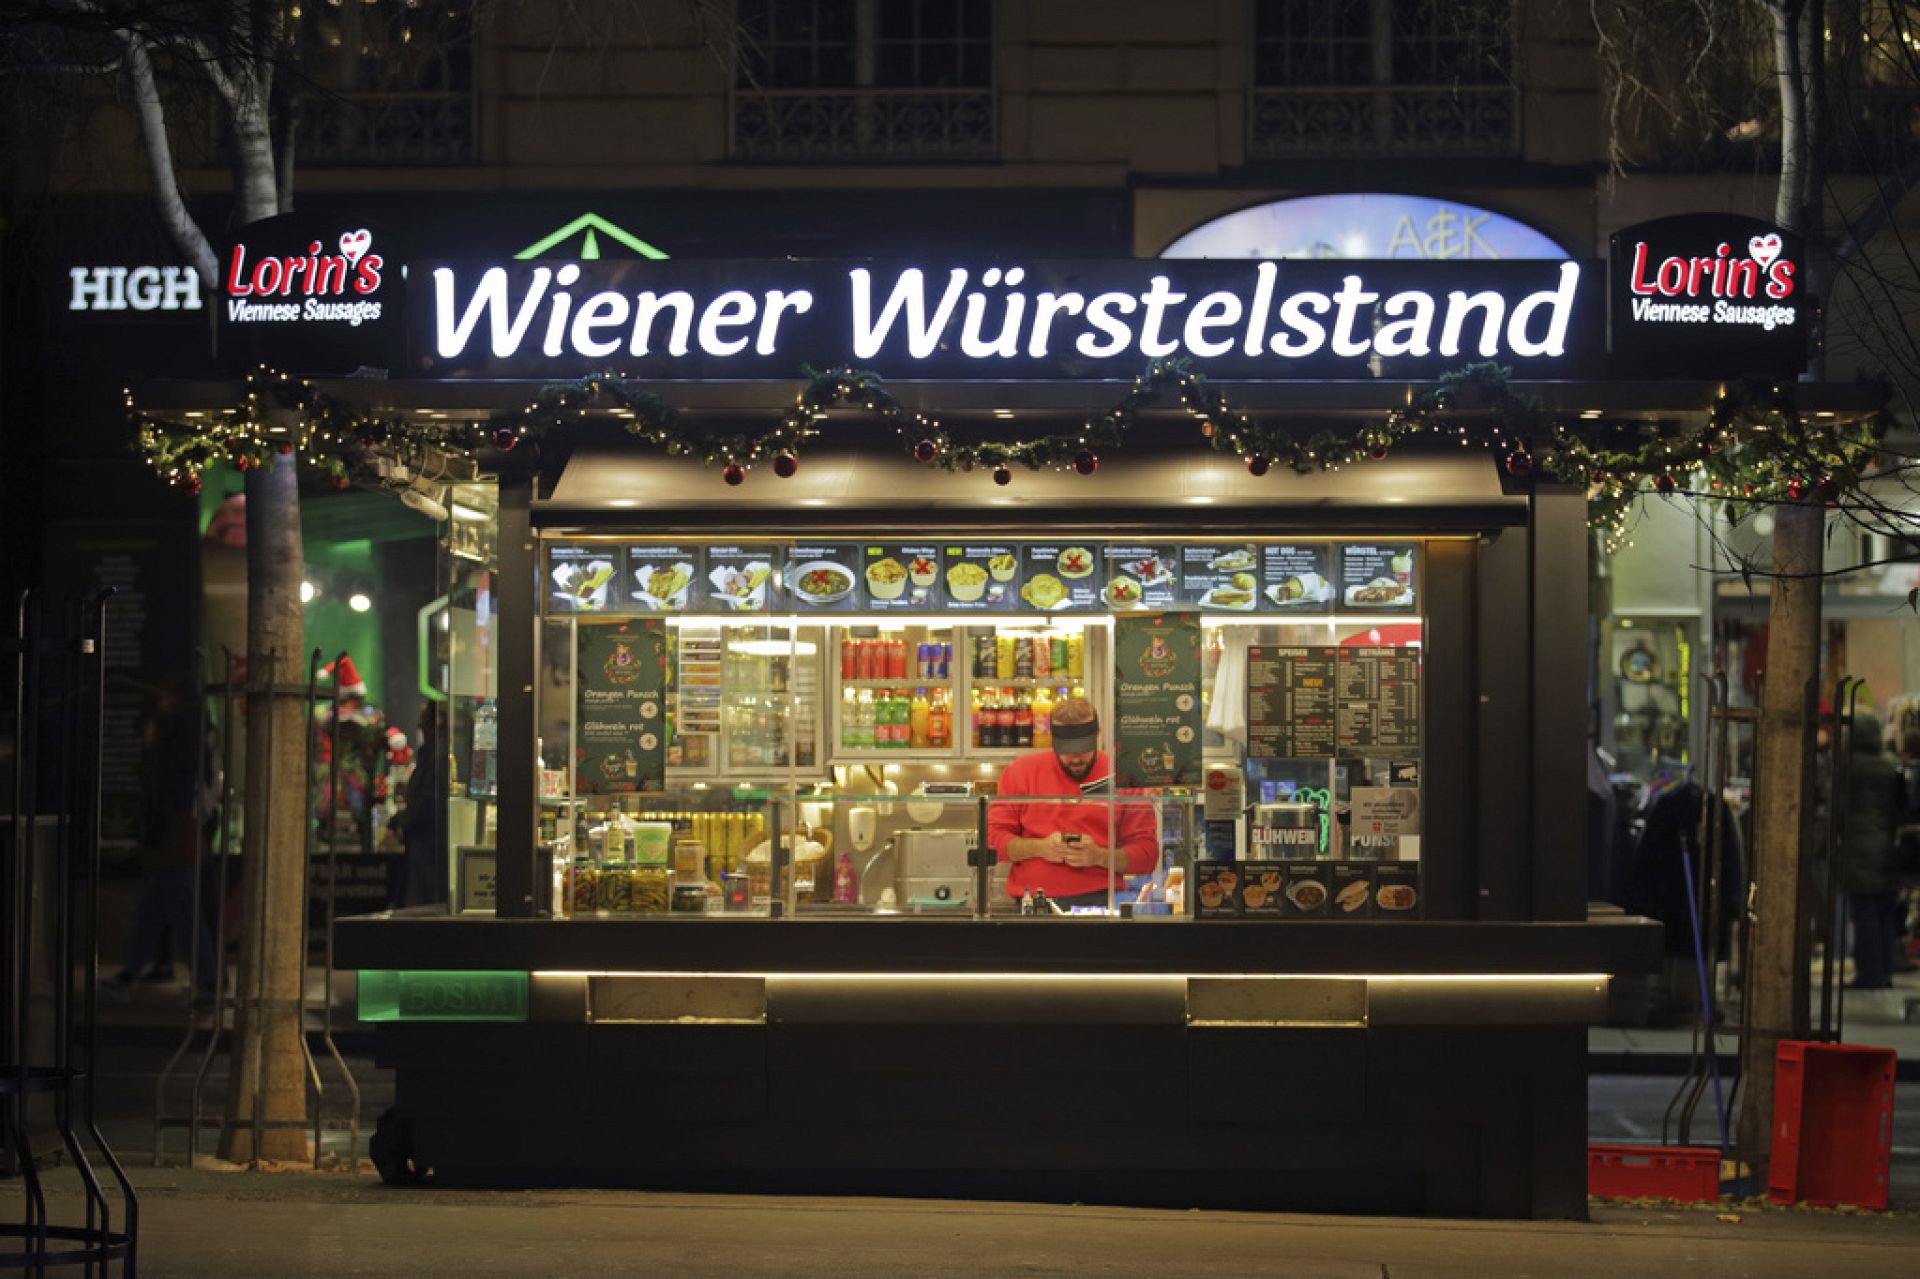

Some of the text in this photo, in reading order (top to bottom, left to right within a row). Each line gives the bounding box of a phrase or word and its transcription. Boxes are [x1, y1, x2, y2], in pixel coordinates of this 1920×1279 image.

[68, 265, 201, 311] HIGH
[227, 240, 384, 297] Lorin's
[1630, 241, 1796, 298] Lorin's
[227, 297, 382, 327] Viennese Sausages
[432, 261, 1580, 359] Wiener Würstelstand
[1631, 297, 1796, 331] Viennese Sausages
